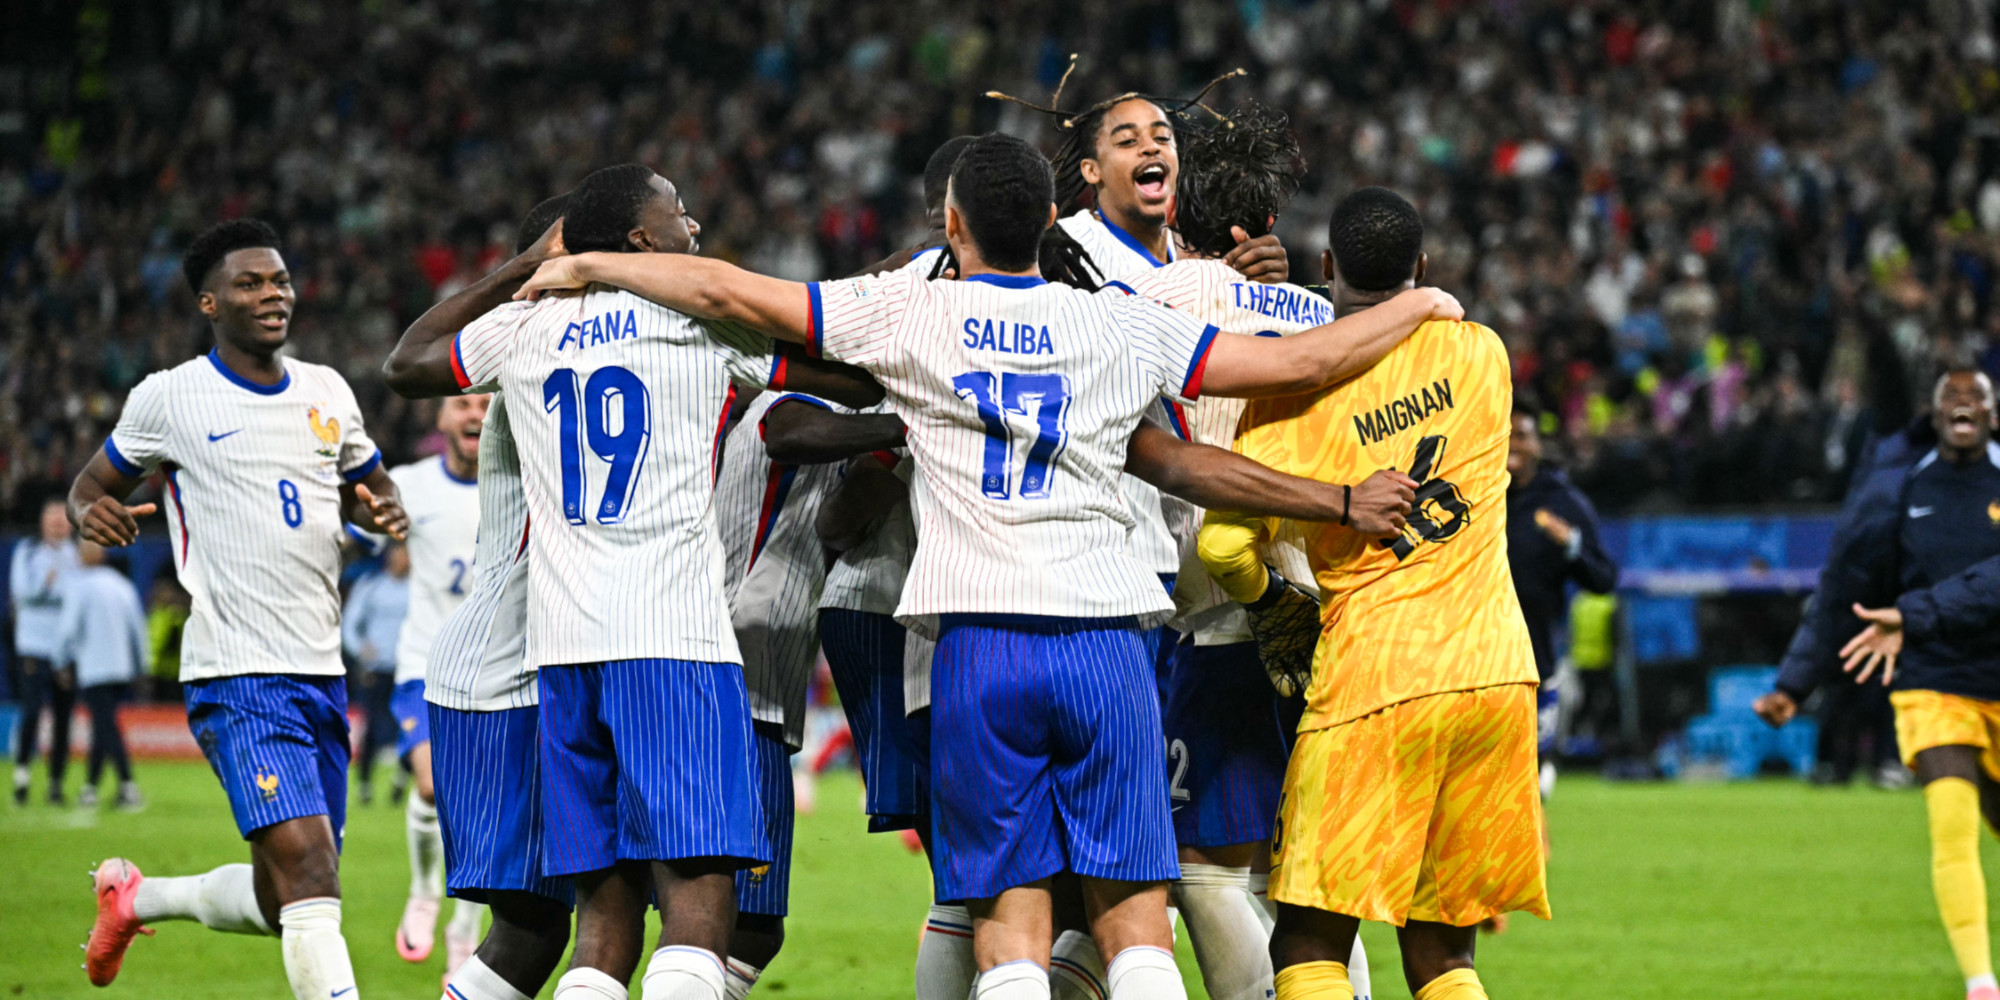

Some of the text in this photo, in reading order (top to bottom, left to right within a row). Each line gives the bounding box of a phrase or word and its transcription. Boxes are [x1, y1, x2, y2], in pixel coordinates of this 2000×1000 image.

[557, 309, 638, 351] FFANA
[963, 317, 1054, 354] SALIBA
[951, 371, 1072, 500] 17
[1353, 378, 1454, 446] MAIGNAN
[543, 365, 651, 526] 19
[278, 479, 303, 528] 8
